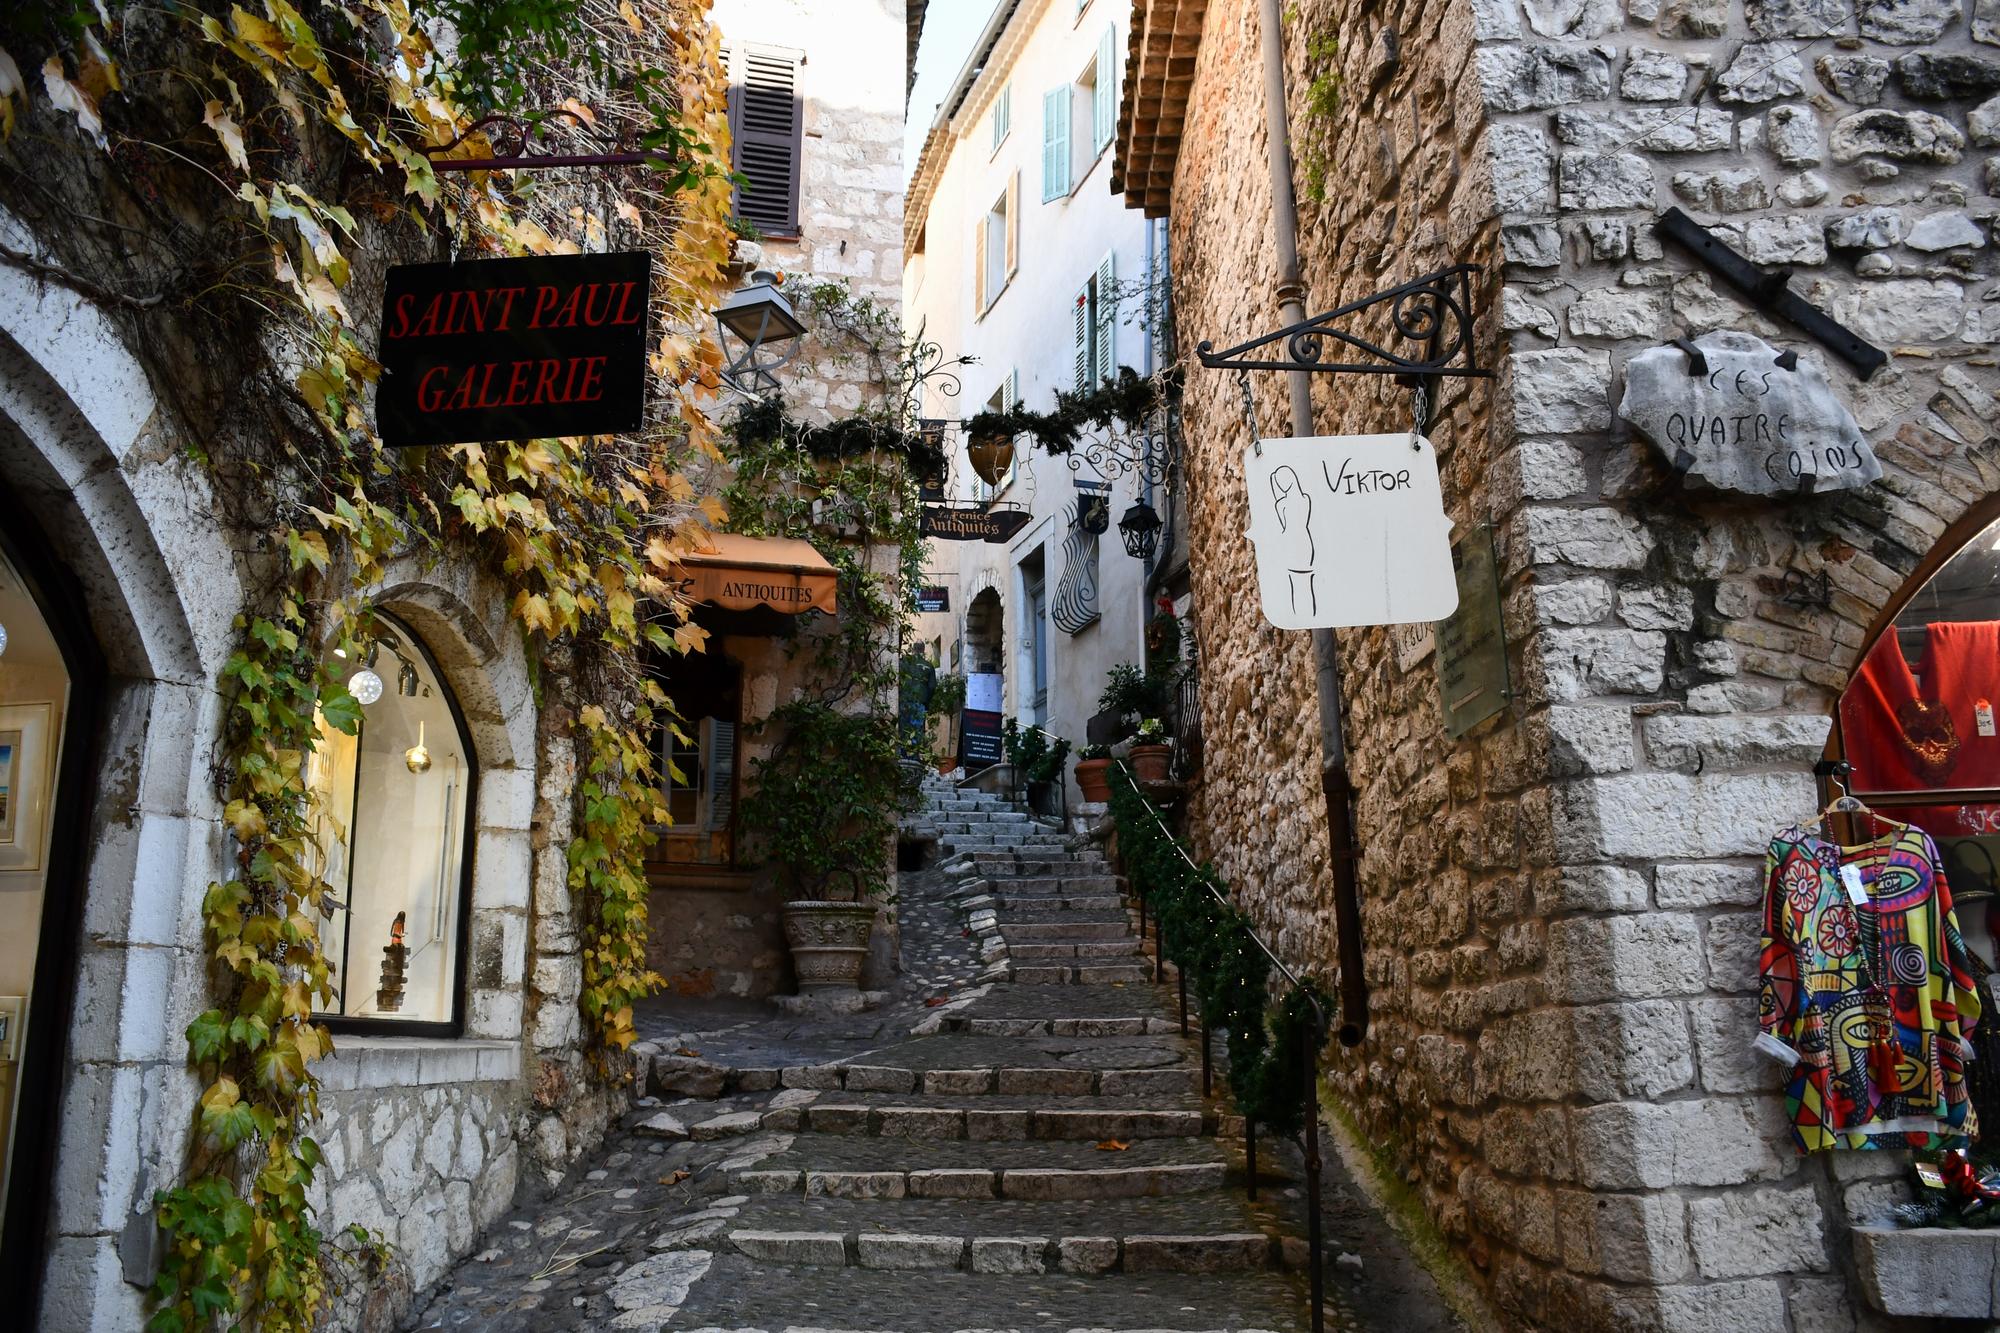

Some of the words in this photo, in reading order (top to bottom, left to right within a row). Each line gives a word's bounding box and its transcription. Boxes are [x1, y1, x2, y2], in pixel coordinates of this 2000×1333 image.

[388, 286, 527, 340] SAINT
[526, 281, 641, 330] PAUL
[417, 356, 608, 413] GALERIE
[1709, 367, 1773, 396] CES
[1322, 457, 1412, 495] VIKTOR
[926, 517, 1001, 537] Antiquités
[723, 582, 813, 603] ANTIQUITES
